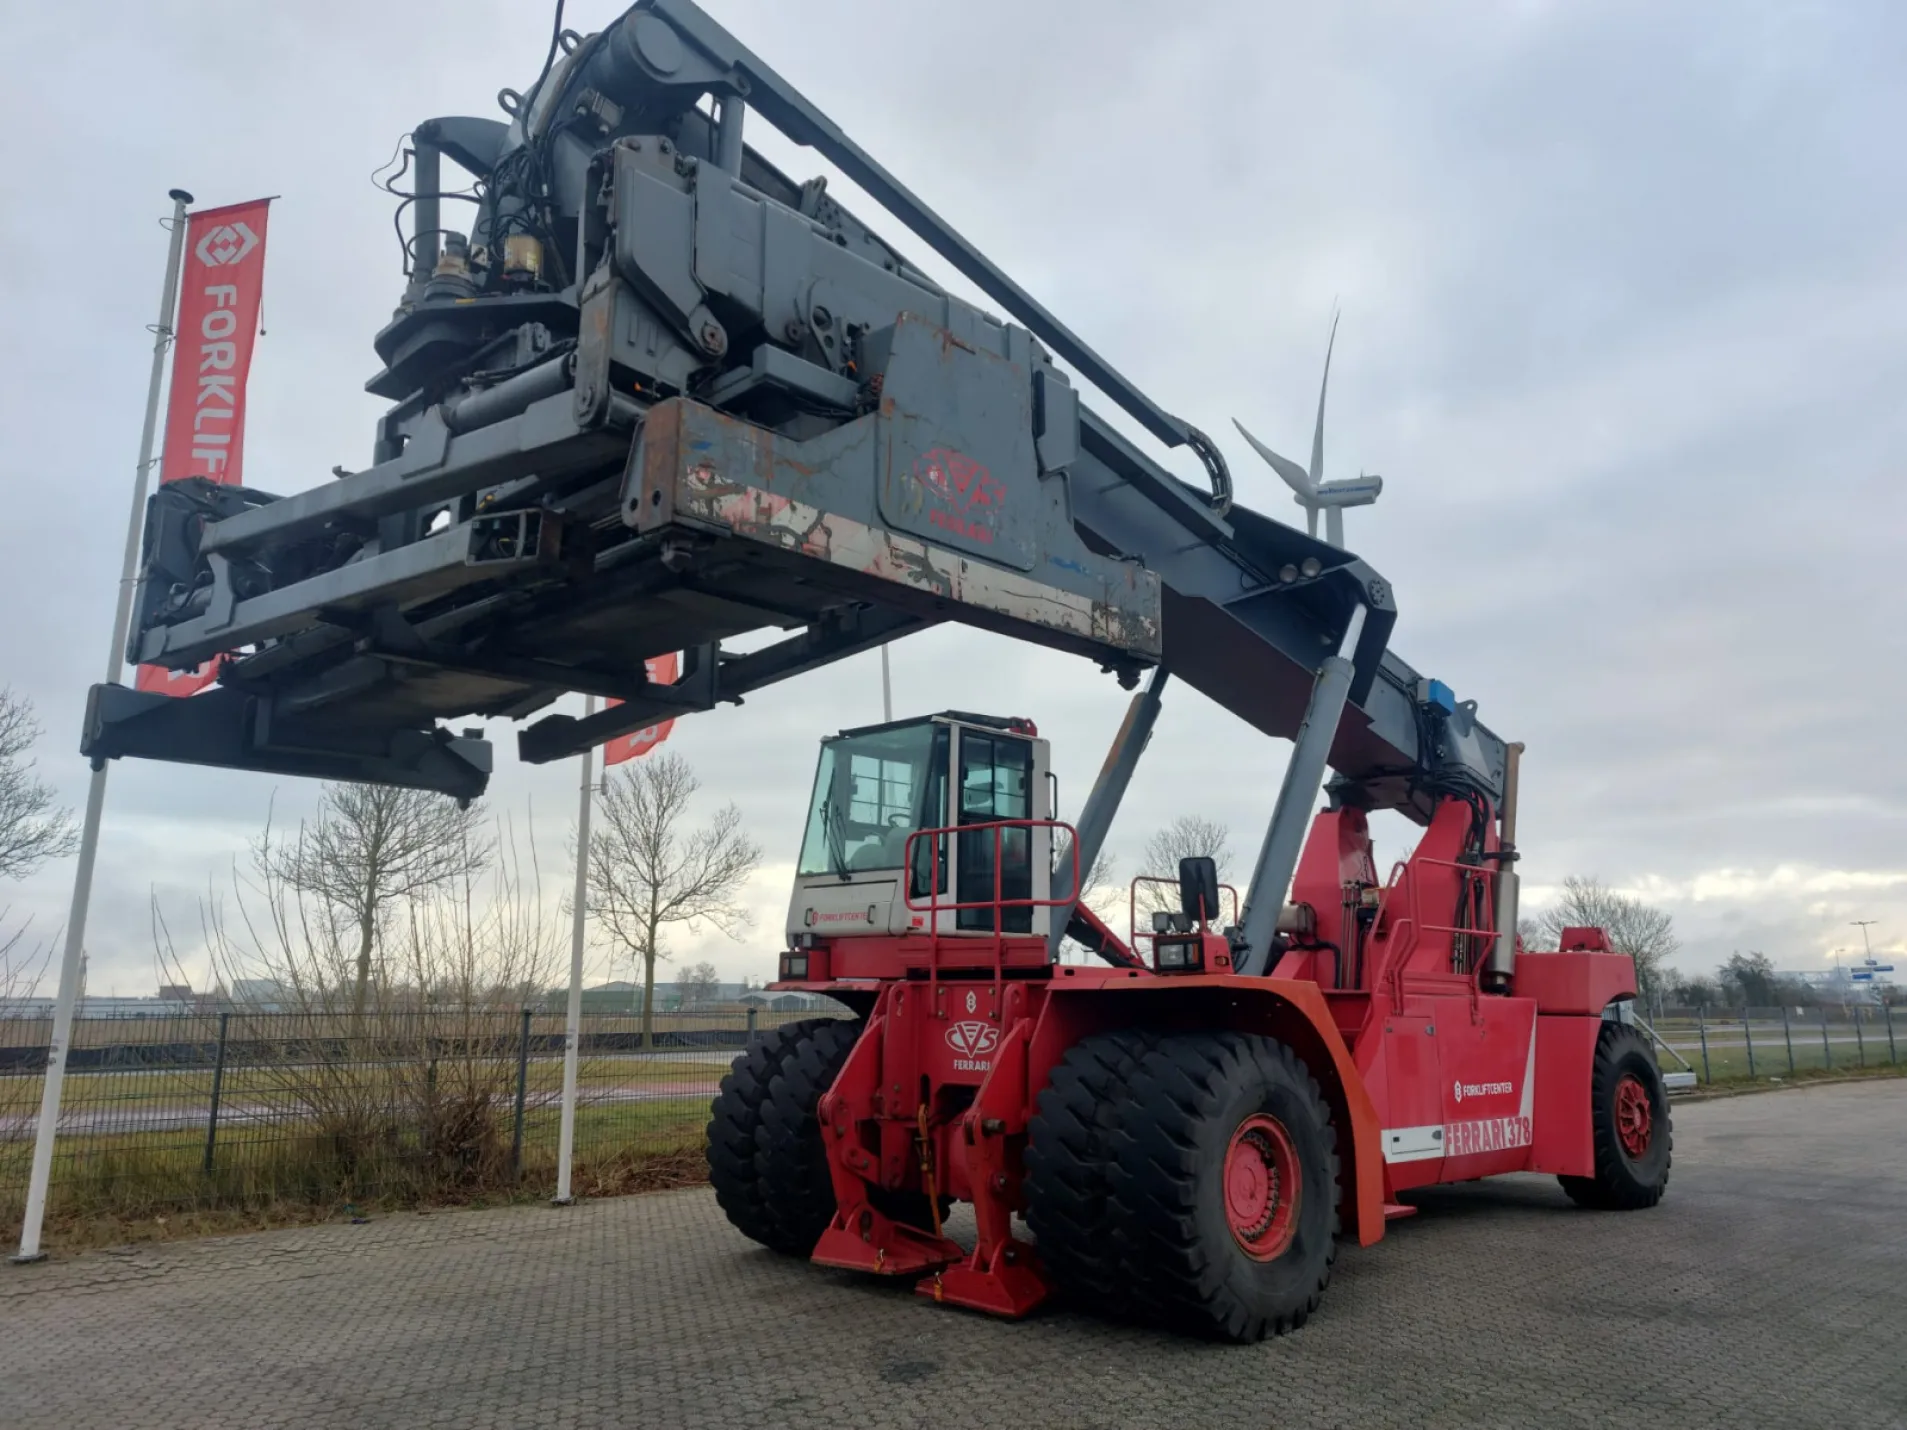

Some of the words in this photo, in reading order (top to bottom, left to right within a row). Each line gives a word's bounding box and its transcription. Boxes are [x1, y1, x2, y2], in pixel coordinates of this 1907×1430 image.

[192, 284, 237, 485] FORKLIF
[945, 1021, 1000, 1058] CVS
[954, 1060, 990, 1071] FERRARI
[1463, 1081, 1513, 1097] FORKLIFTCENTER
[1445, 1118, 1507, 1156] FERRARI
[1508, 1116, 1532, 1146] 378
